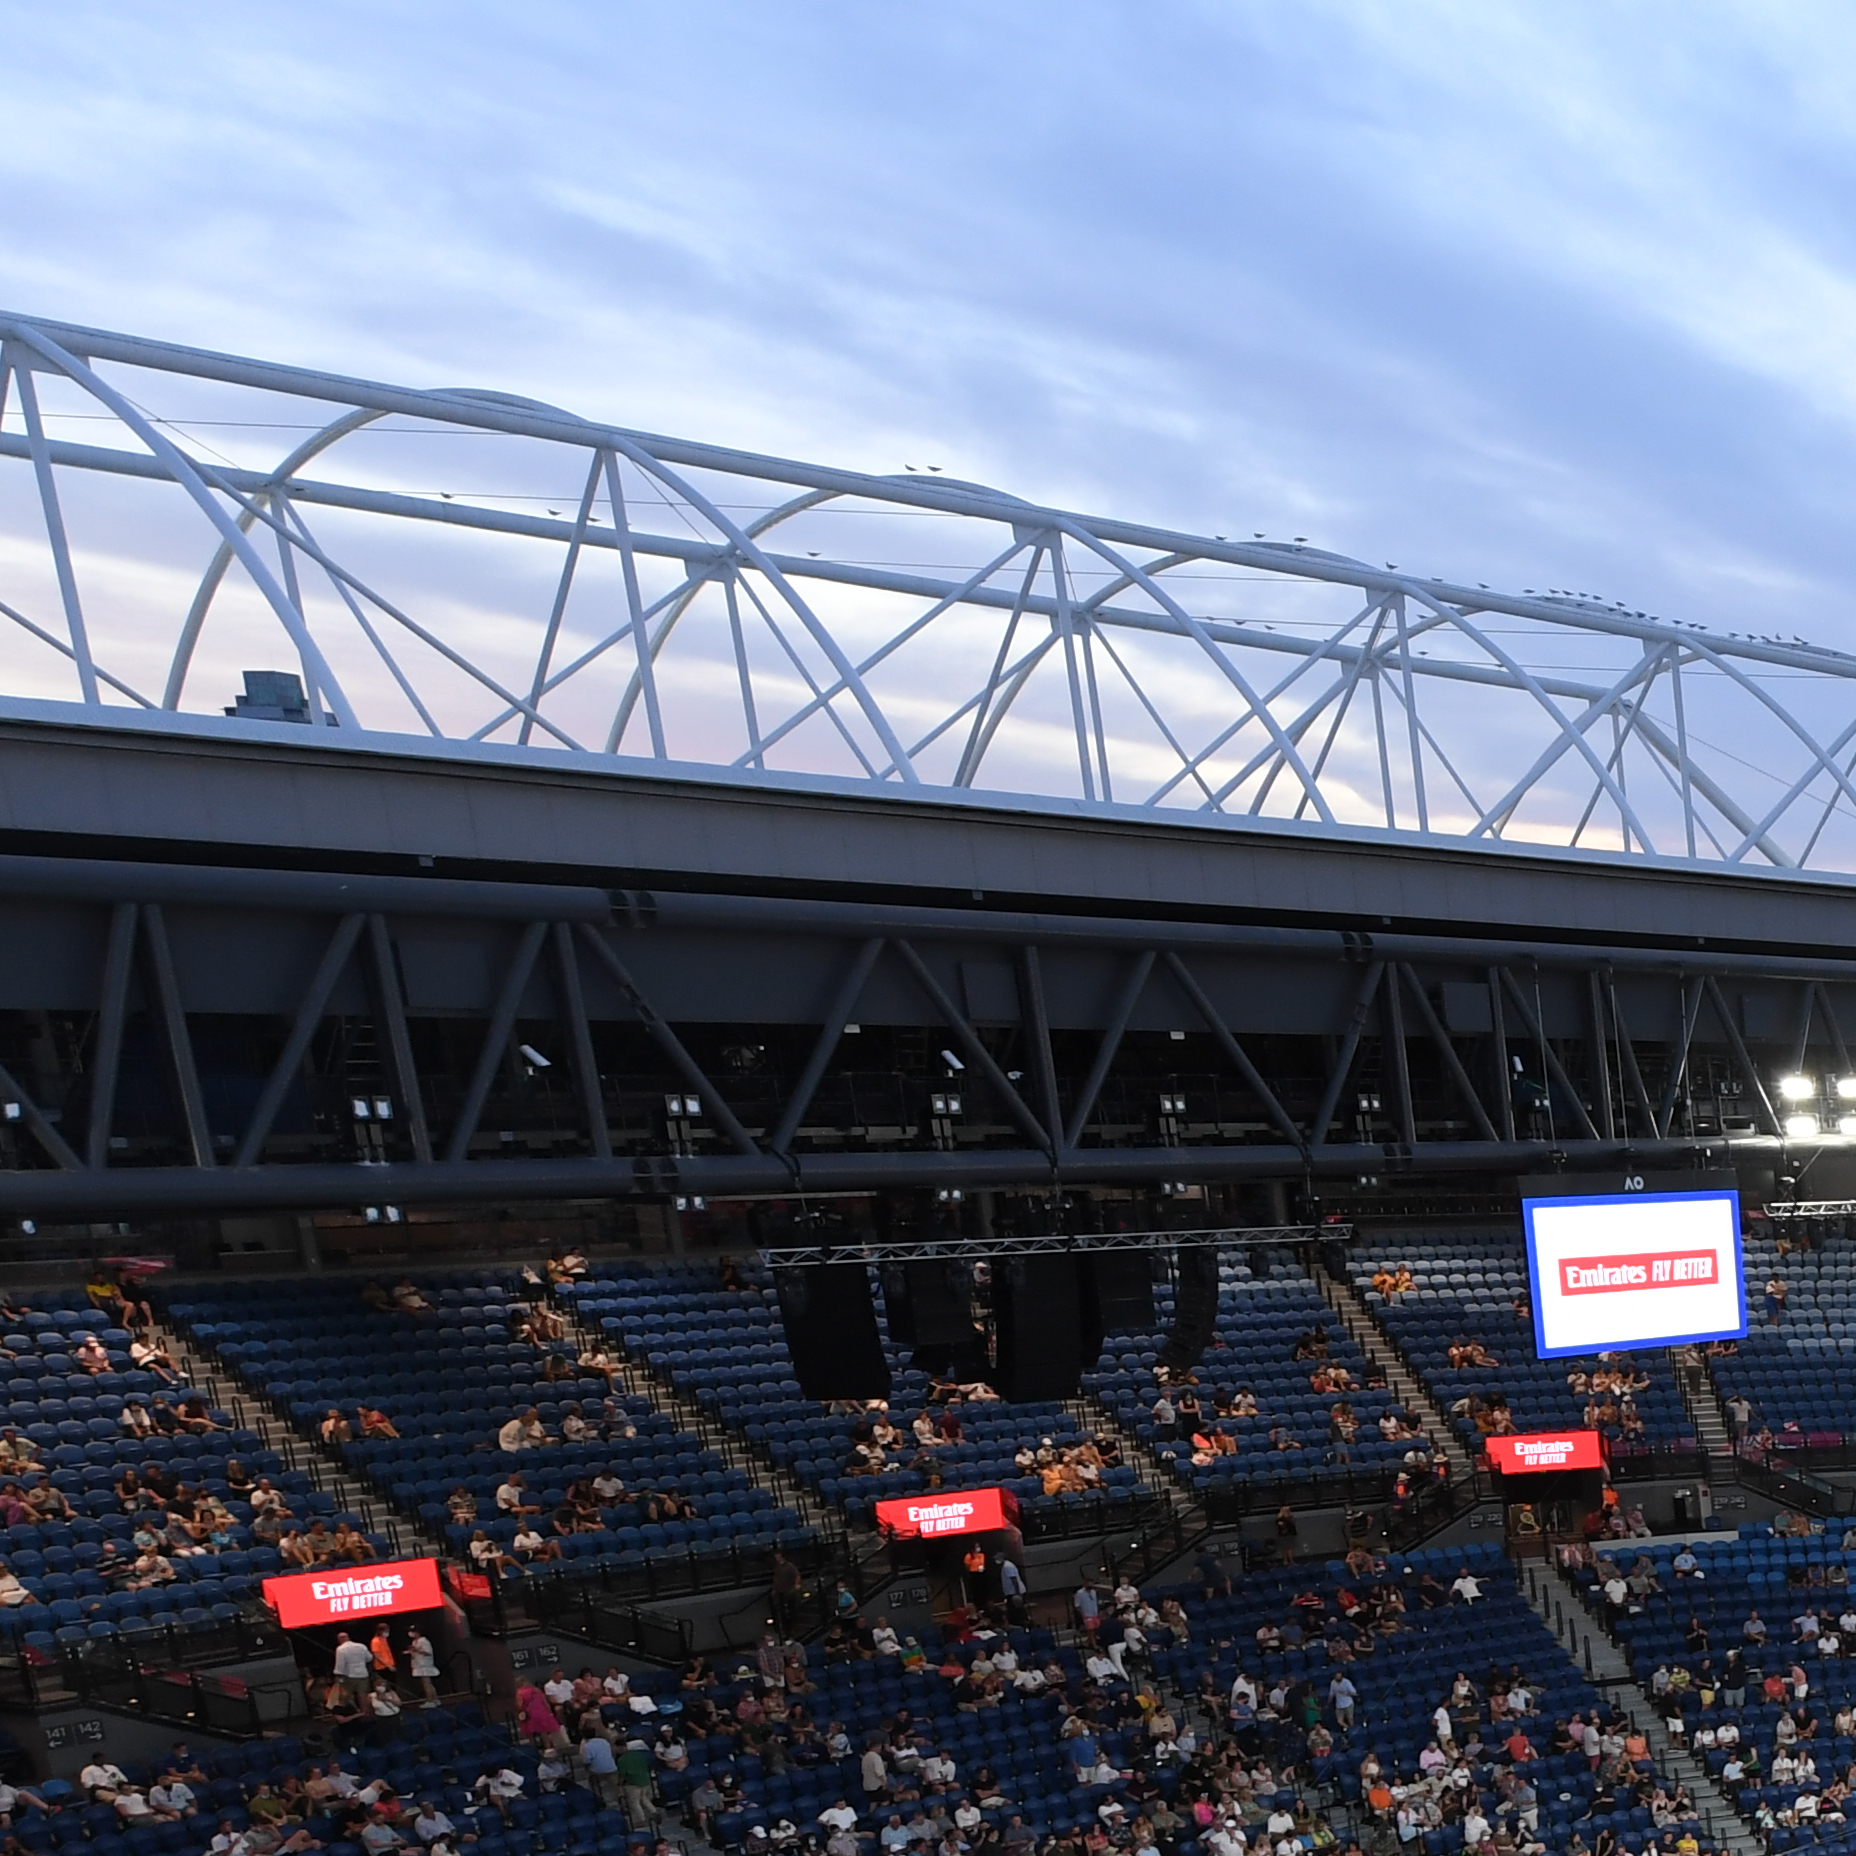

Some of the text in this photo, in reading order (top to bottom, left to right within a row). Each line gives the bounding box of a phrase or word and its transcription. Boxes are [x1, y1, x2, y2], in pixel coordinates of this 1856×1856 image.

[1625, 1176, 1645, 1191] AO
[1566, 1257, 1713, 1289] Emirates FLY BETTER
[1514, 1440, 1575, 1456] Emirates
[1525, 1452, 1567, 1466] FLY BETTER
[907, 1502, 973, 1522] Emirates
[935, 1516, 966, 1531] BETTER
[312, 1575, 403, 1600] Emirates
[330, 1592, 393, 1614] FLY BETTER
[890, 1592, 904, 1601] 177
[511, 1646, 558, 1661] 161 162
[46, 1721, 101, 1739] 141 142
